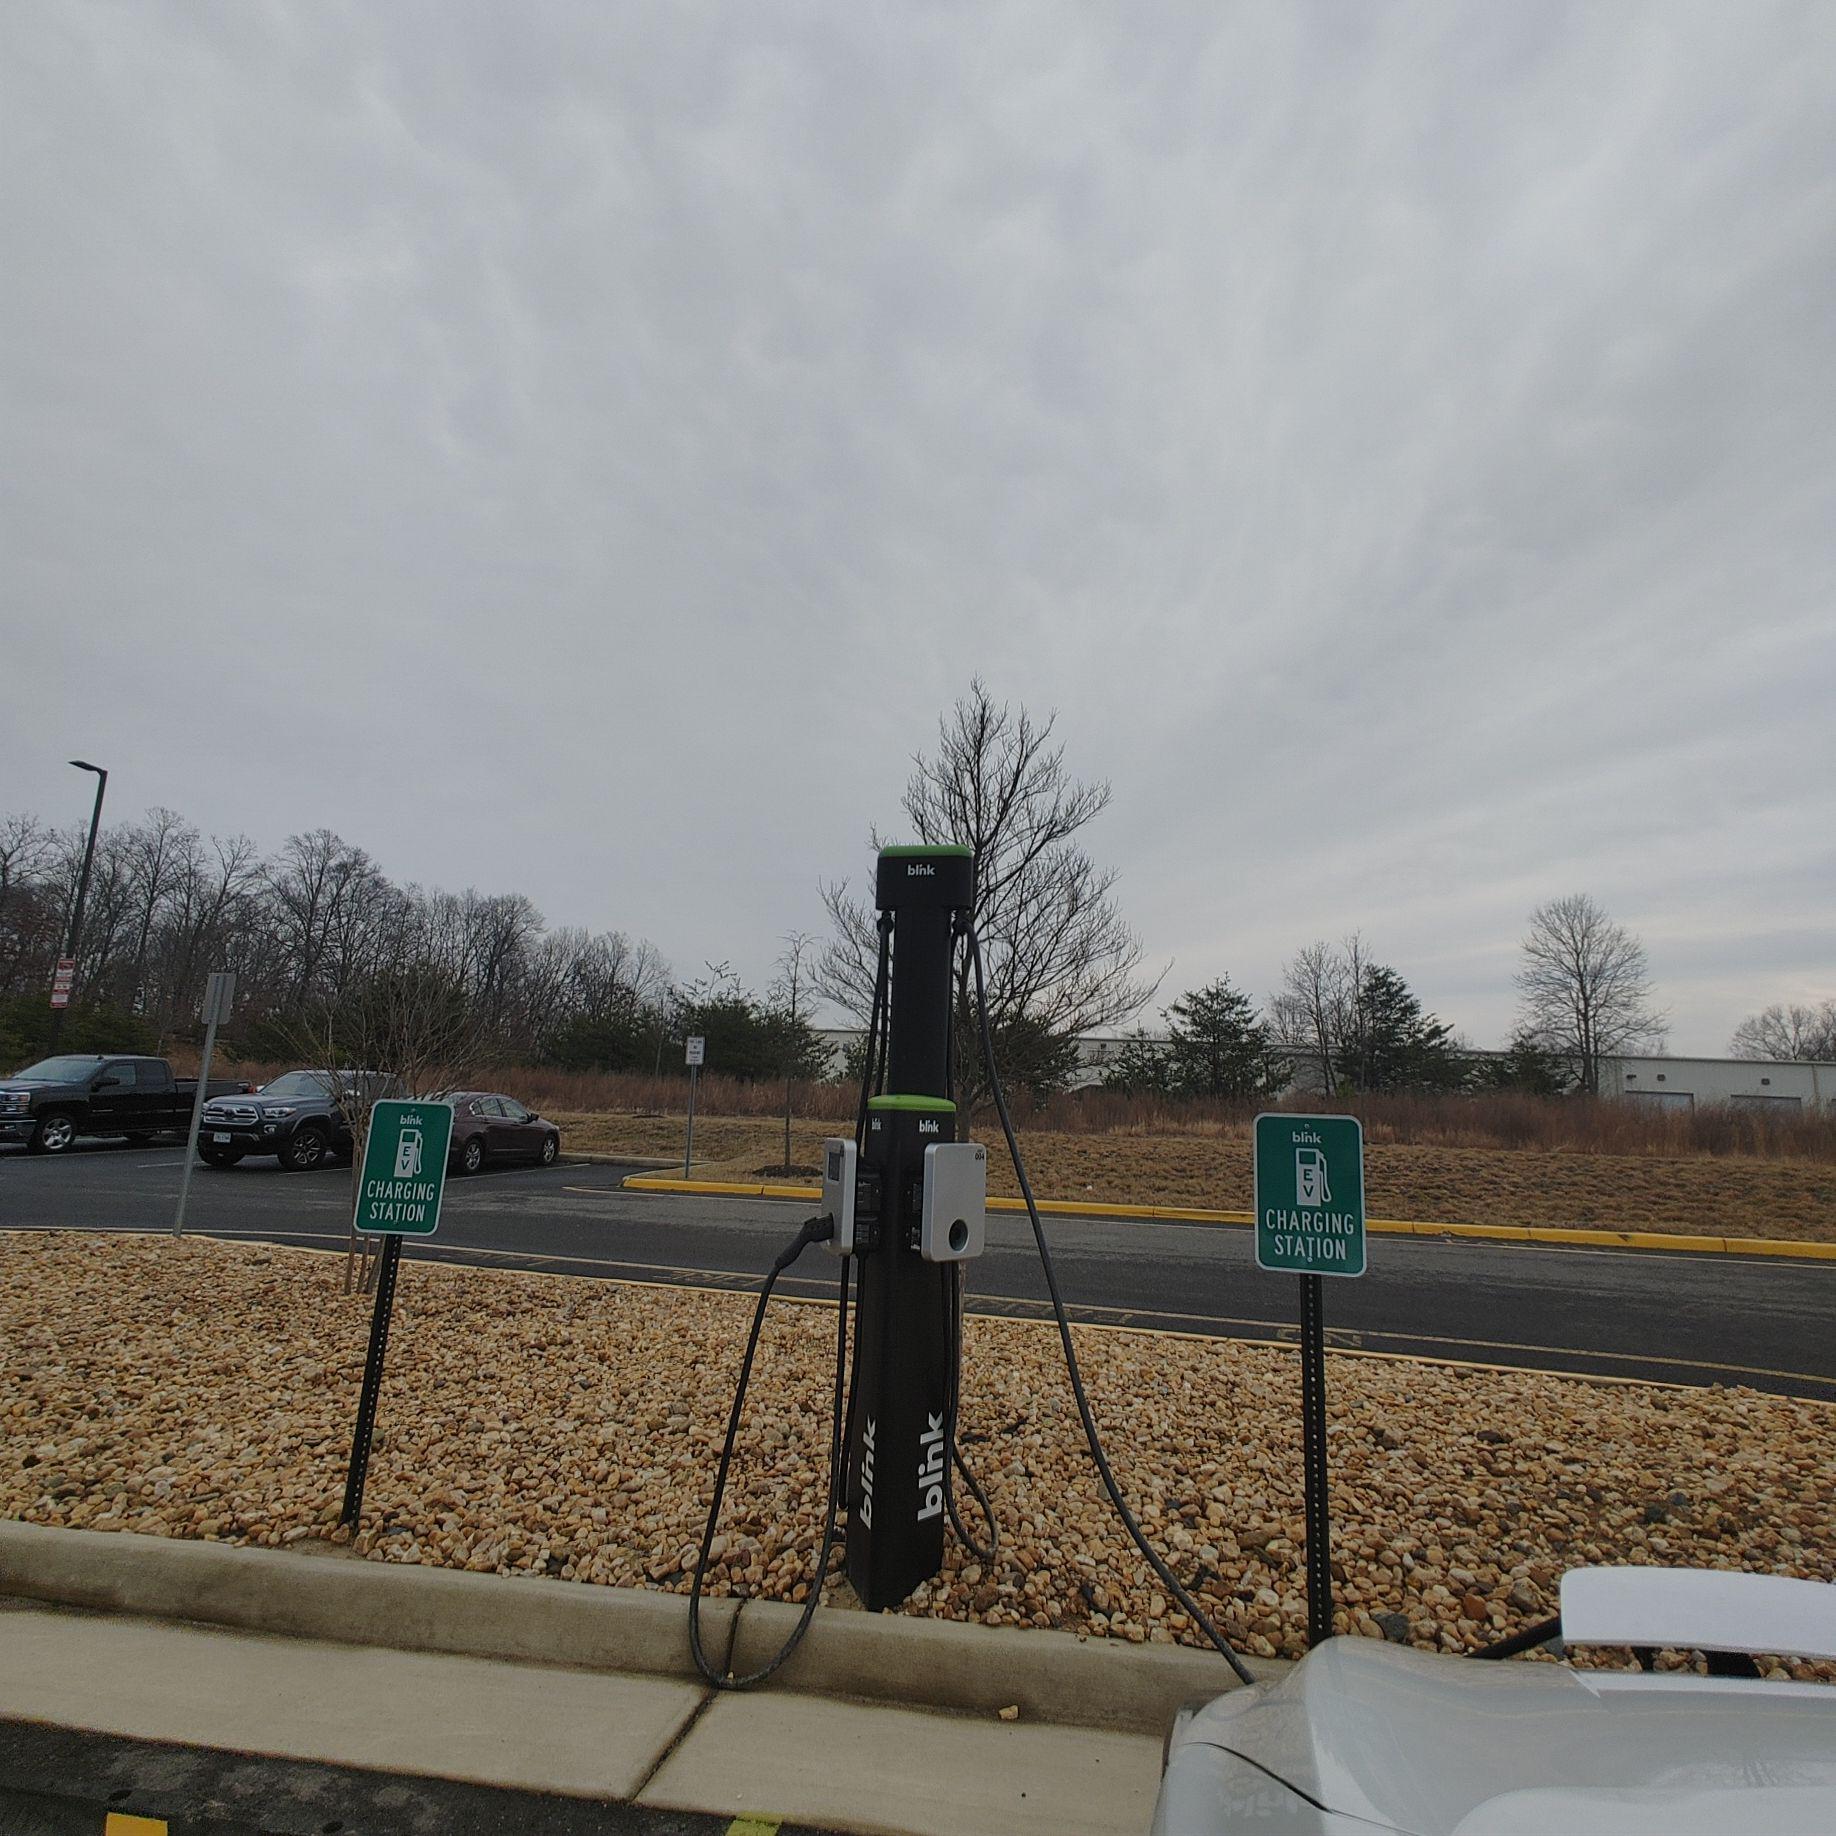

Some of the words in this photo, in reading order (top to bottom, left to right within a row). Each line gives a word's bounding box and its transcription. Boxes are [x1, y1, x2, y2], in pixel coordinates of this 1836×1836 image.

[907, 863, 936, 876] blink
[400, 1114, 423, 1125] blink
[919, 1119, 940, 1133] blink
[1292, 1131, 1323, 1144] blink
[367, 1180, 436, 1201] CHARGING
[370, 1202, 426, 1222] STATION
[1266, 1208, 1355, 1235] CHARGING
[1274, 1234, 1347, 1261] STATION
[859, 1413, 876, 1531] blink
[918, 1411, 944, 1521] blink
